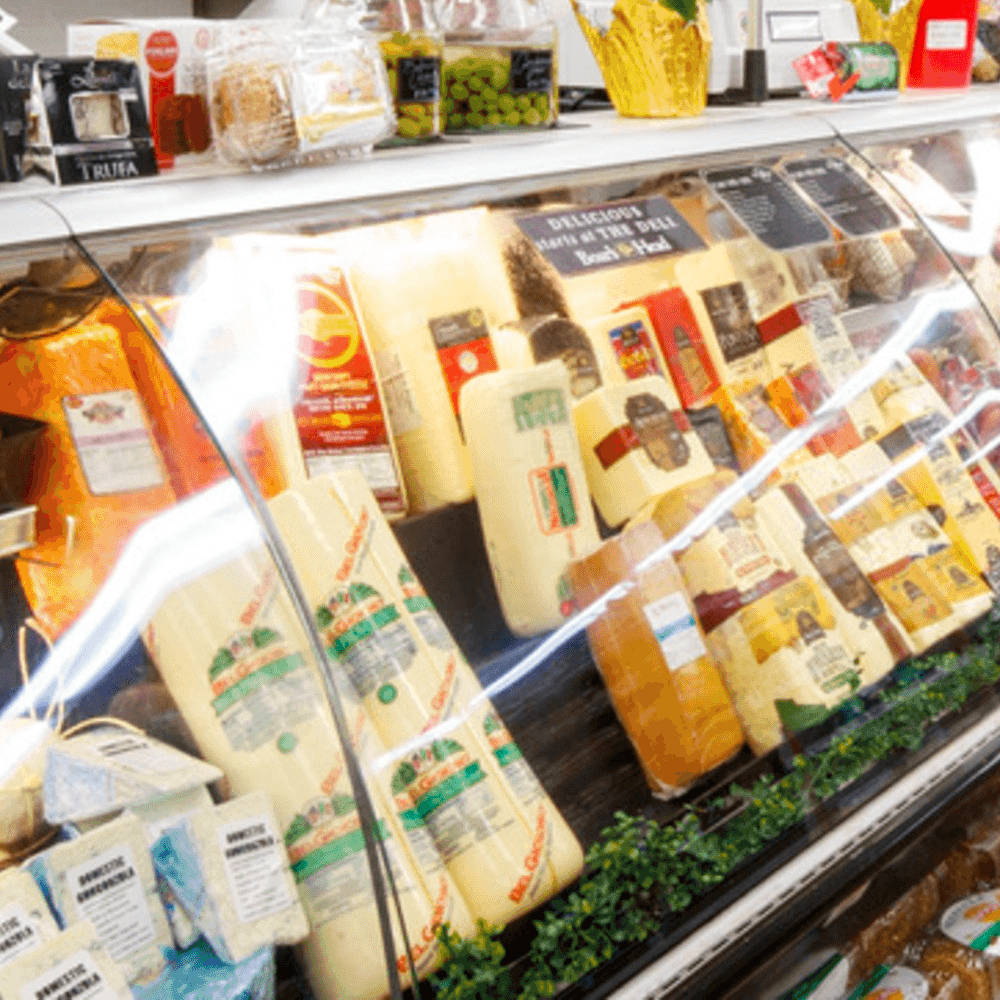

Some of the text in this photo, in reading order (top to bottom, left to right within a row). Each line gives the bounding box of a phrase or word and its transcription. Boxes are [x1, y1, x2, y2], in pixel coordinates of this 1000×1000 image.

[546, 204, 644, 231] DELICIOUS
[595, 222, 635, 241] THE
[634, 215, 680, 234] DELI
[78, 854, 128, 888] DOMESTIC
